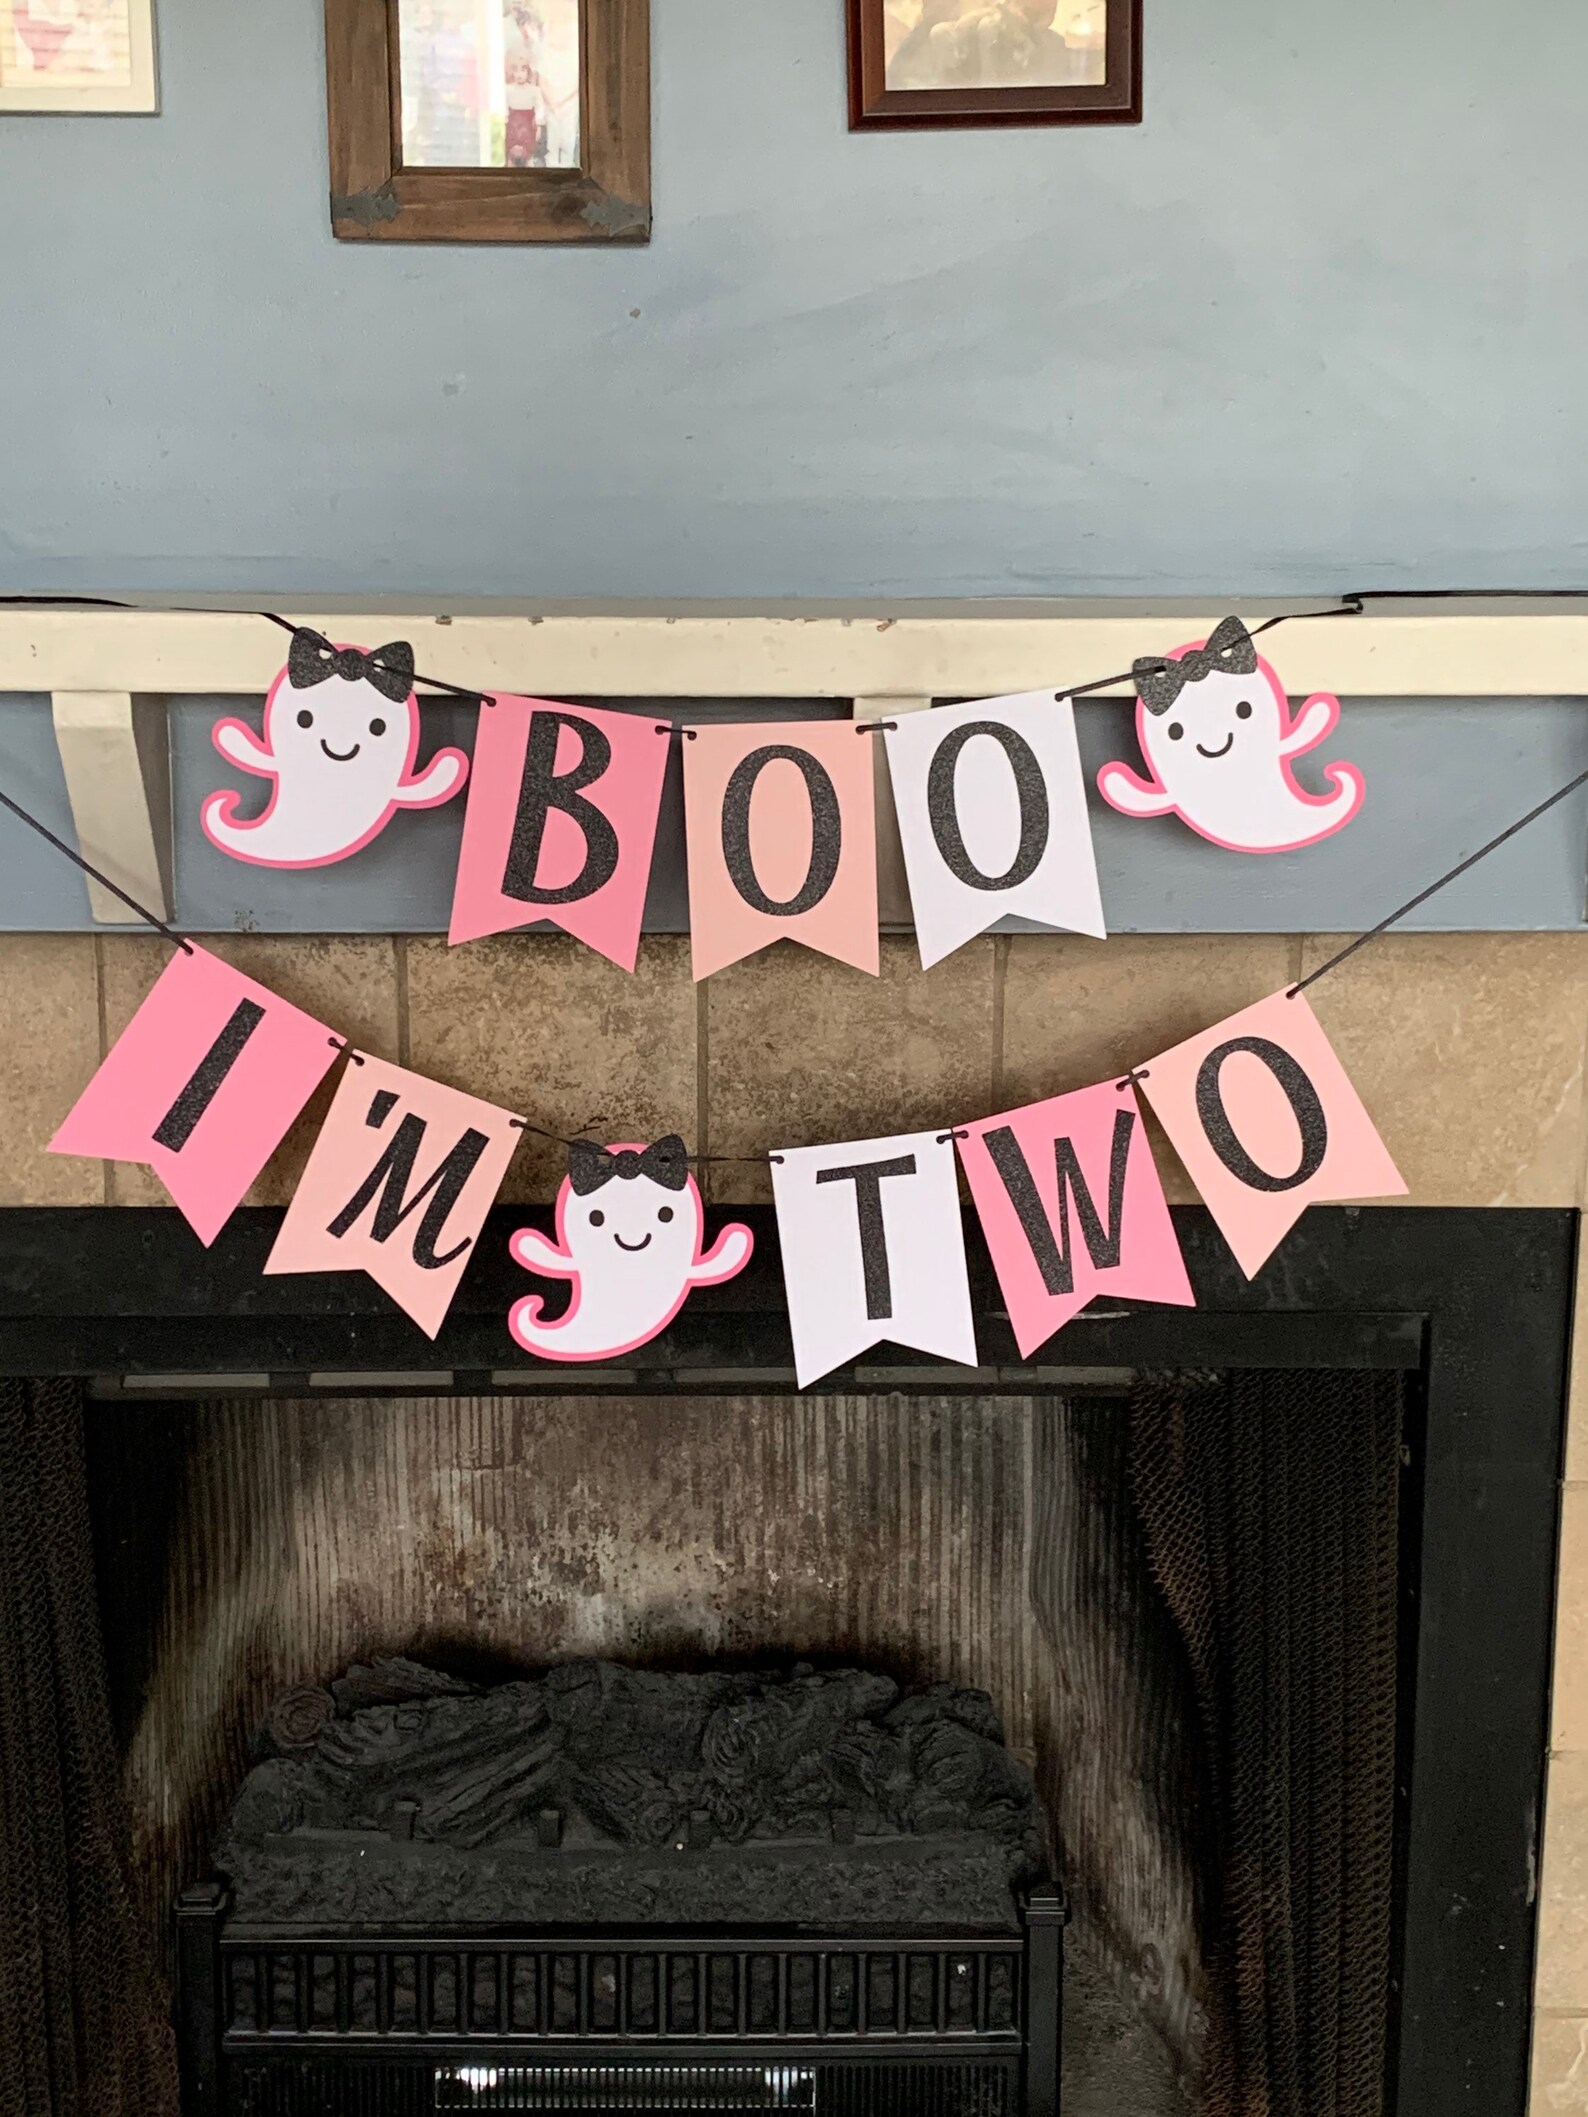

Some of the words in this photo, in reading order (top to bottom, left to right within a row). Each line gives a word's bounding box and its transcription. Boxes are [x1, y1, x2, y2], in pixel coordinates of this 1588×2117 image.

[501, 710, 1049, 916] BOO
[152, 997, 490, 1270] I'M
[816, 1036, 1329, 1320] TWO
